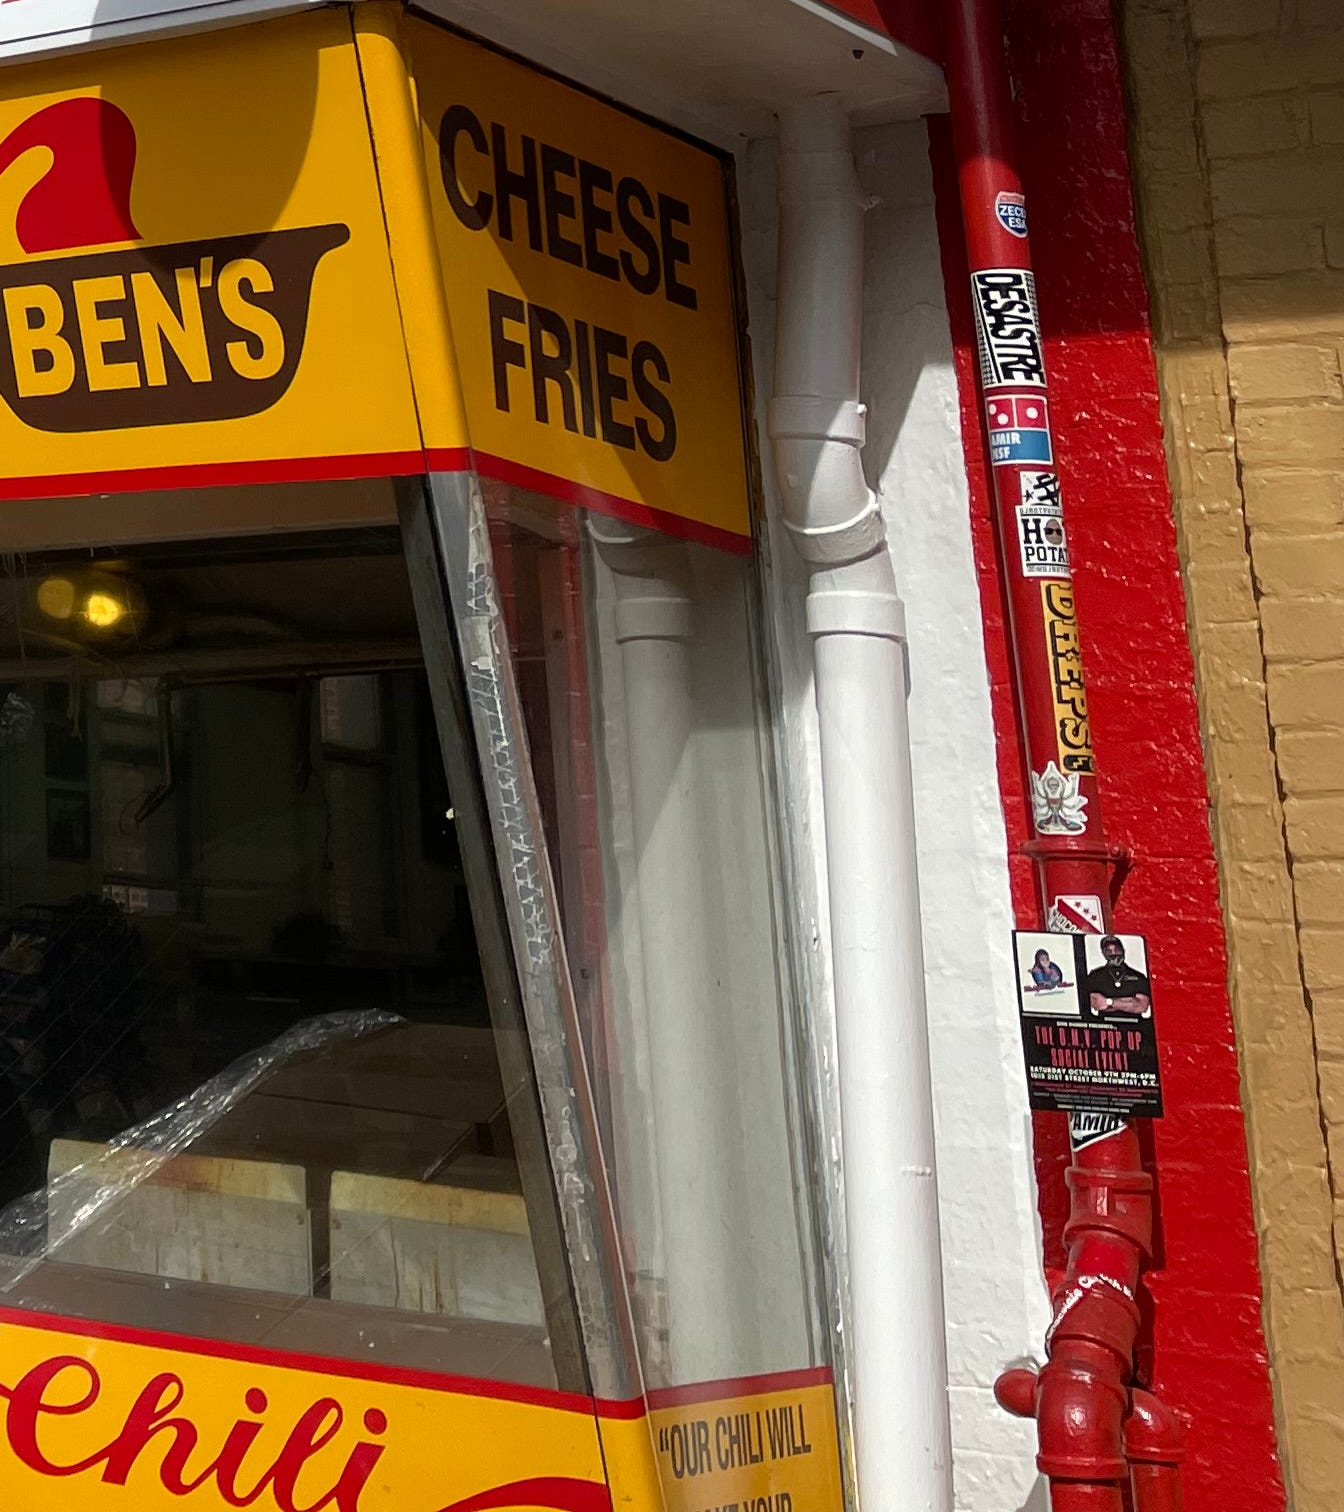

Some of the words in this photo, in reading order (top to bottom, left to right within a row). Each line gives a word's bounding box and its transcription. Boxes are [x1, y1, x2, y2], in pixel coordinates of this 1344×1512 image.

[439, 104, 698, 312] CHEESE
[3, 256, 287, 399] BEN'S
[487, 287, 677, 462] FRIES
[976, 273, 1046, 385] DESASTRE
[6, 1354, 387, 1512] Chili
[715, 1411, 764, 1470] CHILI
[766, 1404, 812, 1460] WILL
